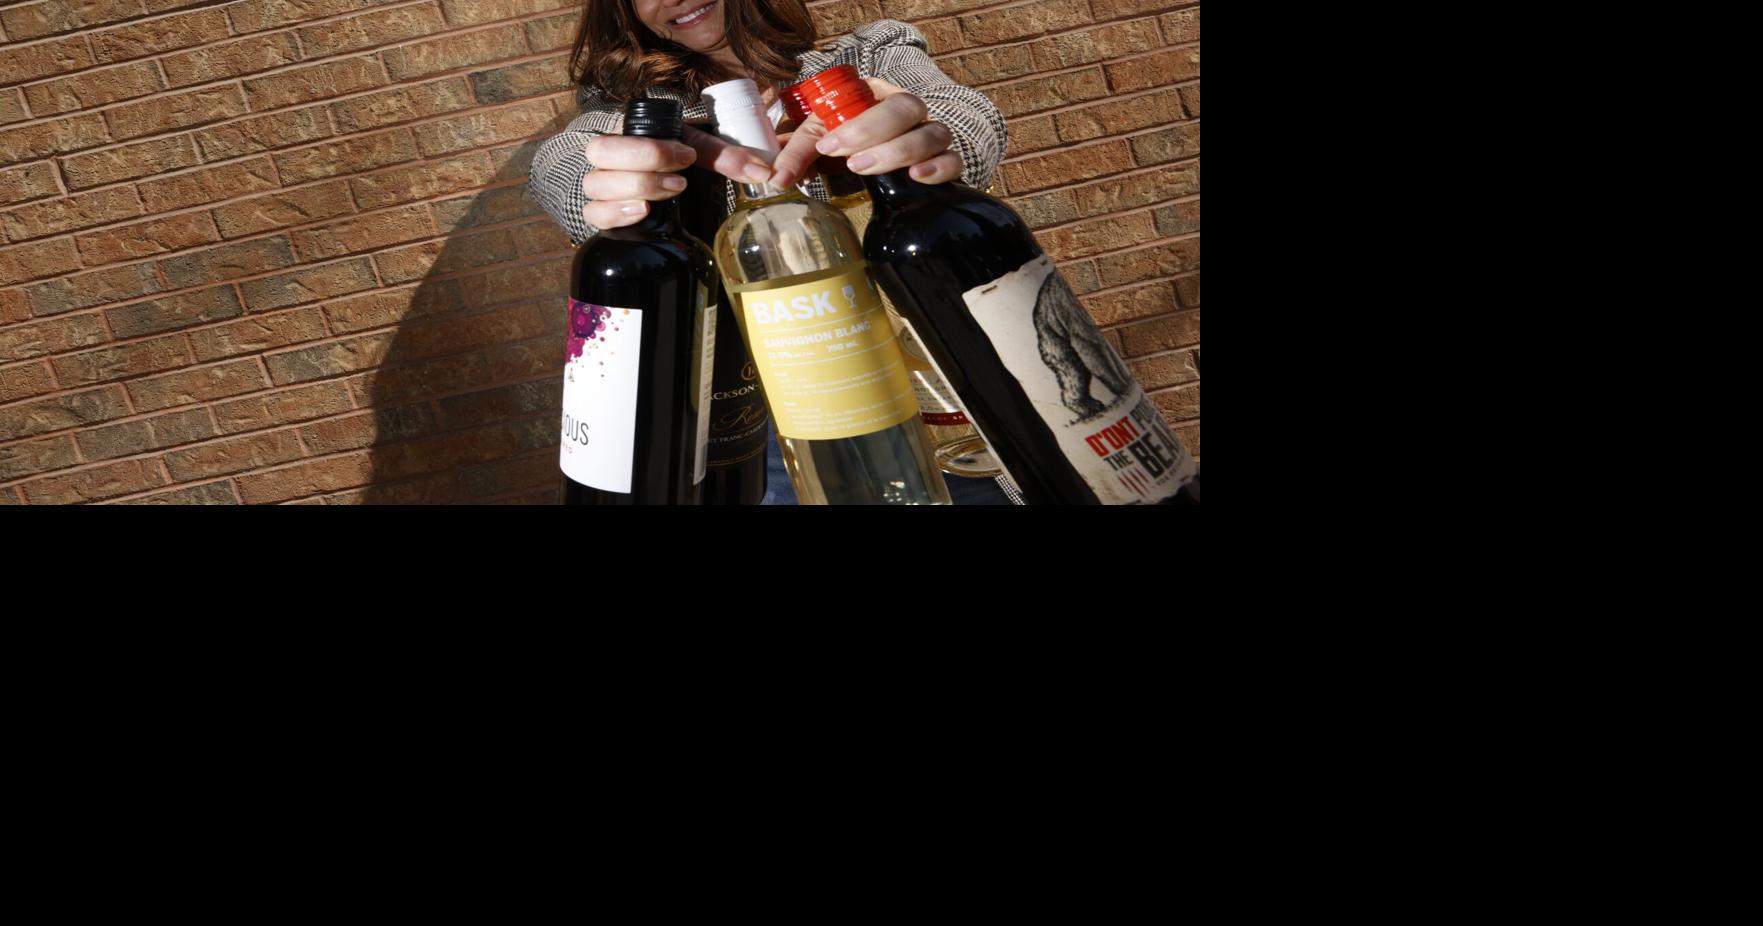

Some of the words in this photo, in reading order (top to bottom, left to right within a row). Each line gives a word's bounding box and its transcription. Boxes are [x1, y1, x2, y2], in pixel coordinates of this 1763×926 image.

[752, 291, 837, 325] BASK
[763, 331, 832, 349] SAUVIGNON
[834, 320, 871, 338] BLANC
[1084, 415, 1140, 457] D'ONT
[1103, 450, 1134, 472] THE
